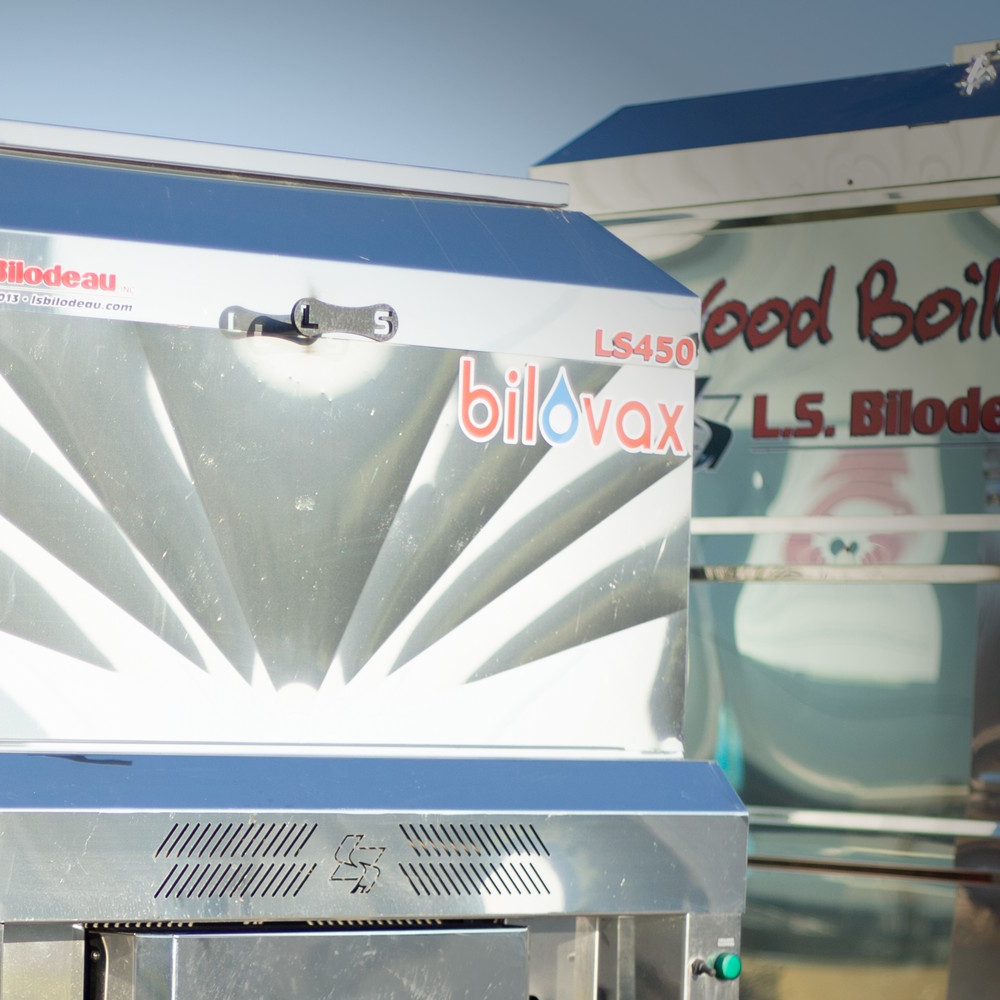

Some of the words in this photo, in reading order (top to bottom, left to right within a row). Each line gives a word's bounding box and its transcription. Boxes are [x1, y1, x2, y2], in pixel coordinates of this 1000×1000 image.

[31, 296, 132, 312] lsbilodeau.com
[701, 264, 836, 352] ood
[857, 258, 1000, 352] Boil
[595, 329, 696, 367] LS450
[459, 356, 687, 455] bilovax
[753, 392, 834, 438] L.S.
